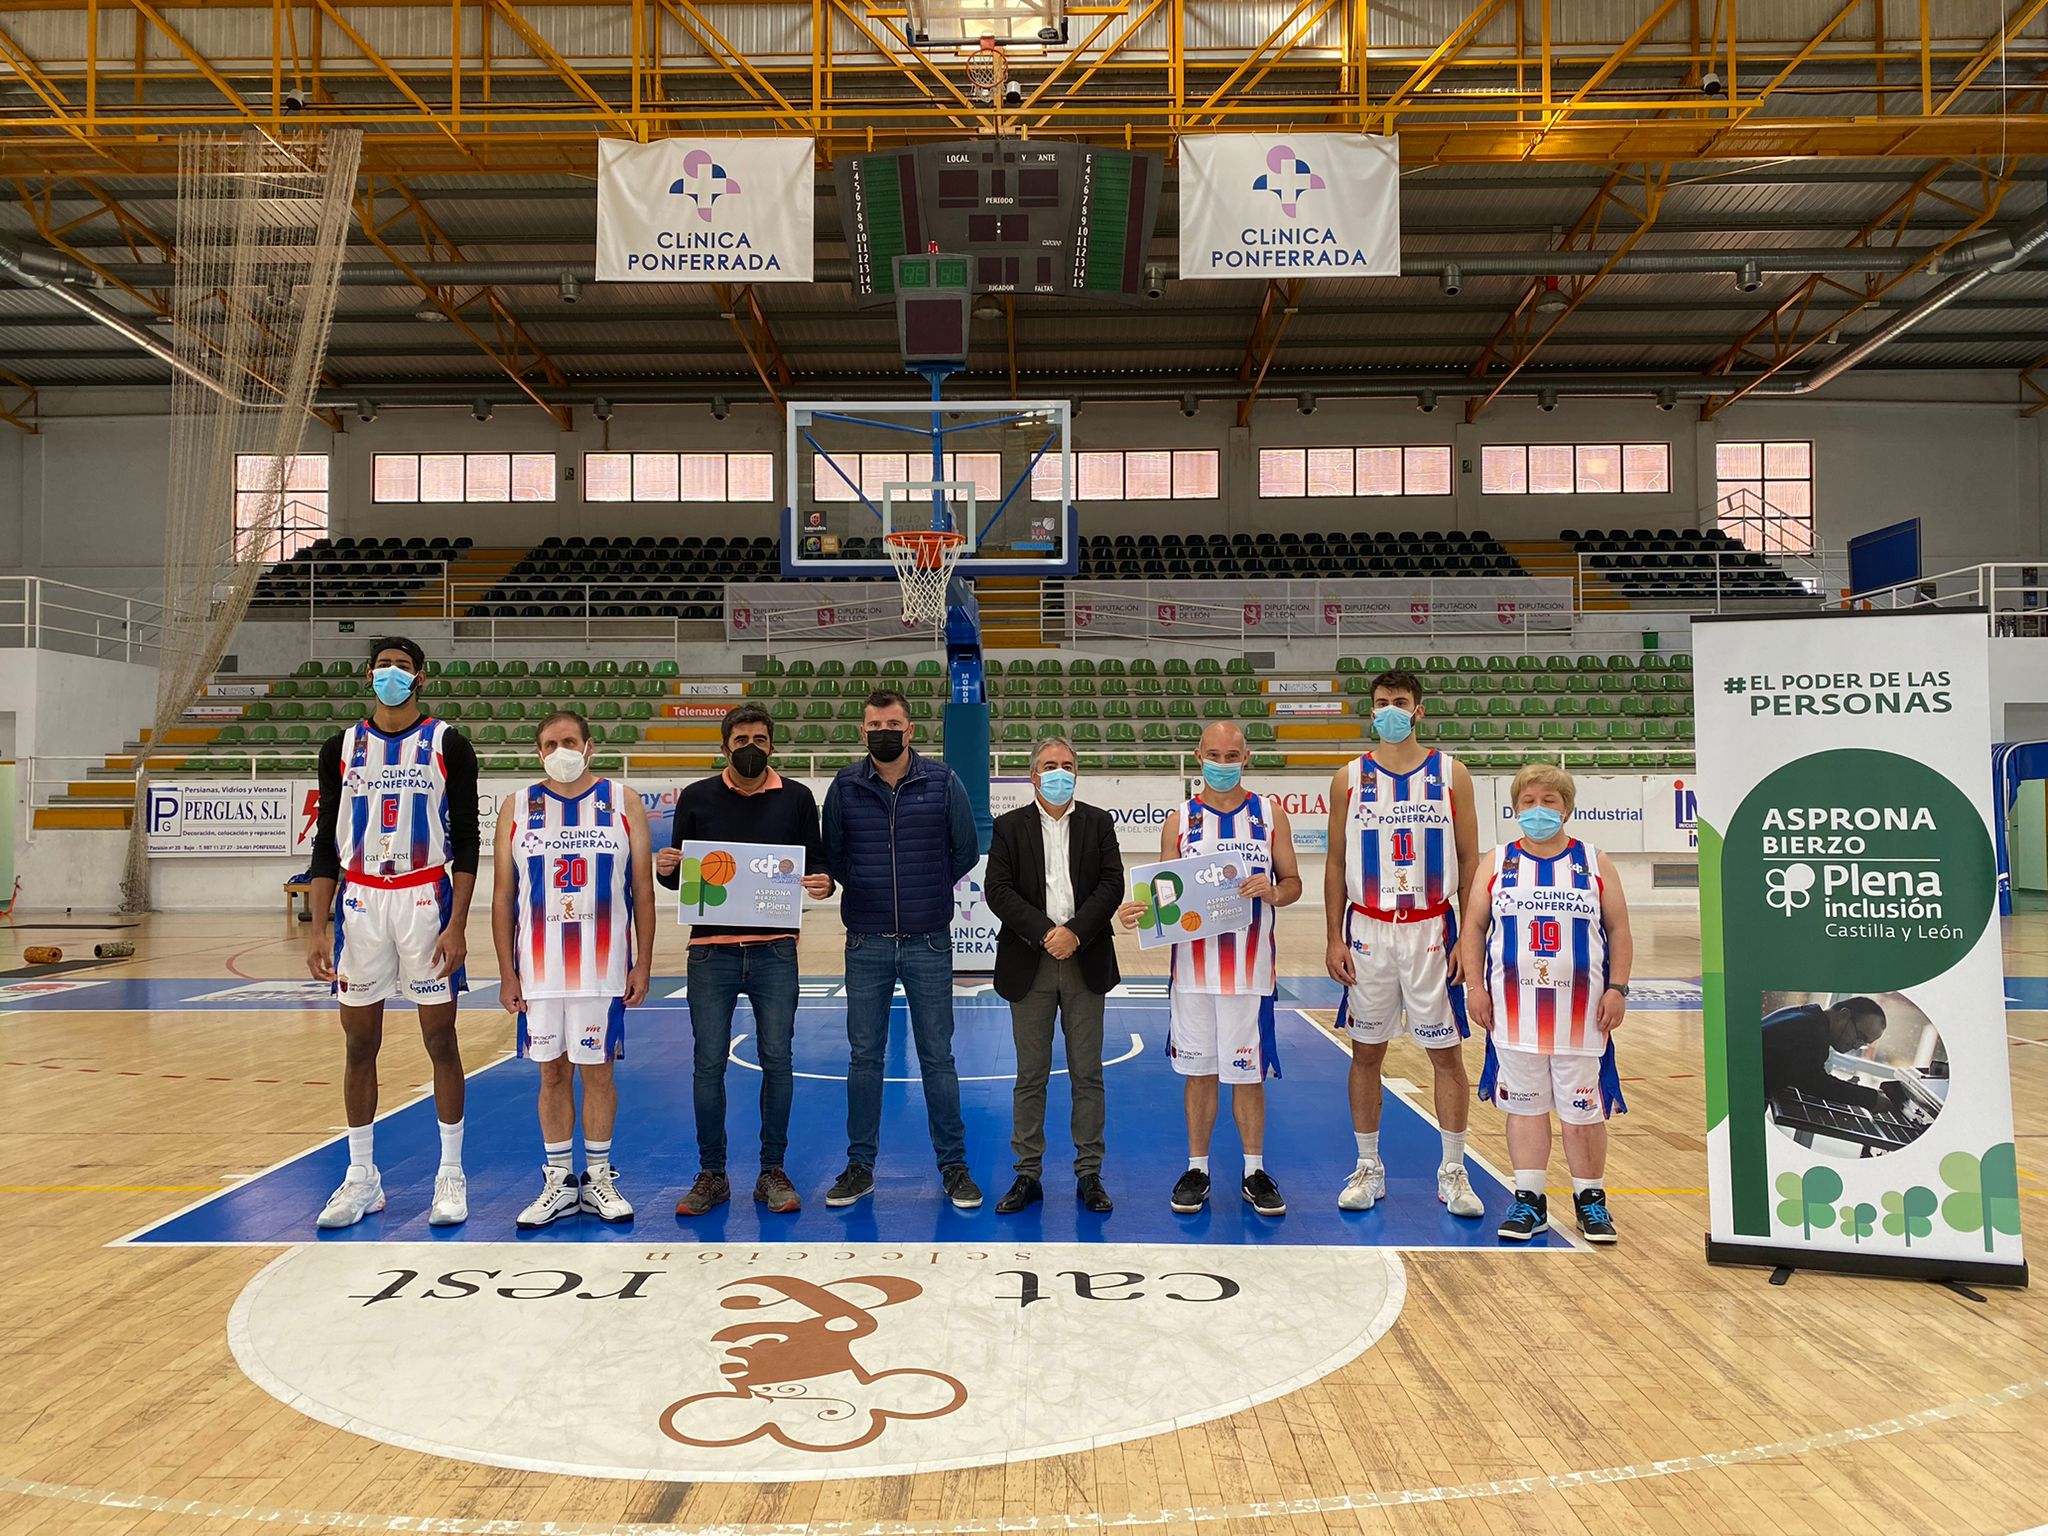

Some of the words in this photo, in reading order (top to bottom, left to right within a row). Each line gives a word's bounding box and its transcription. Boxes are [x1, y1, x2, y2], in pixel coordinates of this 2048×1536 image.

[946, 154, 970, 163] LOCAL
[1086, 154, 1091, 164] E
[853, 161, 858, 170] E
[1086, 166, 1091, 174] 4
[854, 172, 859, 180] 4
[1085, 175, 1090, 184] 5
[854, 182, 860, 190] 5
[1083, 185, 1089, 194] 6
[855, 192, 861, 201] 6
[1083, 196, 1088, 205] 7
[856, 202, 861, 212] 7
[1082, 206, 1087, 215] 8
[857, 213, 863, 221] 8
[1081, 217, 1087, 226] 9
[858, 223, 863, 232] 9
[1078, 227, 1088, 236] 10
[857, 233, 867, 242] 10
[1077, 237, 1087, 246] 11
[858, 244, 868, 253] 11
[1076, 248, 1086, 256] 12
[628, 254, 781, 271] PONFERRADA
[859, 254, 868, 263] 12
[1075, 258, 1085, 267] 13
[1212, 249, 1368, 268] PONFERRADA
[860, 264, 870, 273] 13
[1073, 268, 1085, 277] 14
[860, 275, 871, 284] 14
[1073, 279, 1084, 288] 15
[861, 285, 872, 294] 15
[1782, 673, 1863, 690] PODER
[1869, 671, 1901, 688] DE
[1907, 671, 1951, 687] LAS
[961, 673, 970, 704] MONDO
[1750, 691, 1952, 717] PERSONAS
[672, 706, 728, 717] Telenauto
[367, 779, 435, 790] PONFERRADA
[184, 786, 221, 794] Persianas,
[184, 800, 258, 824] PERGLAS,
[261, 800, 287, 820] S.L.
[382, 798, 399, 828] 6
[1574, 807, 1643, 821] Industrial
[1378, 815, 1450, 825] PONFERRADA
[1762, 807, 1937, 831] ASPRONA
[182, 829, 217, 837] Decoración,
[217, 829, 249, 837] colocación
[545, 840, 620, 850] PONFERRADA
[1391, 833, 1416, 862] 11
[1763, 836, 1866, 855] BIERZO
[365, 853, 379, 862] cat
[392, 851, 409, 860] rest
[553, 857, 588, 889] 20
[1823, 863, 1943, 898] Plena
[1516, 901, 1596, 916] PONFERRADA
[1825, 898, 1943, 919] inclusión
[546, 913, 560, 922] cat
[1528, 919, 1562, 953] 19
[1825, 923, 1896, 939] Castilla
[1903, 927, 1912, 942] y
[1918, 923, 1964, 940] León
[1520, 978, 1534, 986] cat
[1553, 979, 1571, 988] rest
[1414, 1025, 1454, 1038] COSMOS
[645, 1250, 1031, 1265] selección
[348, 1269, 667, 1307] rest
[995, 1270, 1240, 1308] cat
